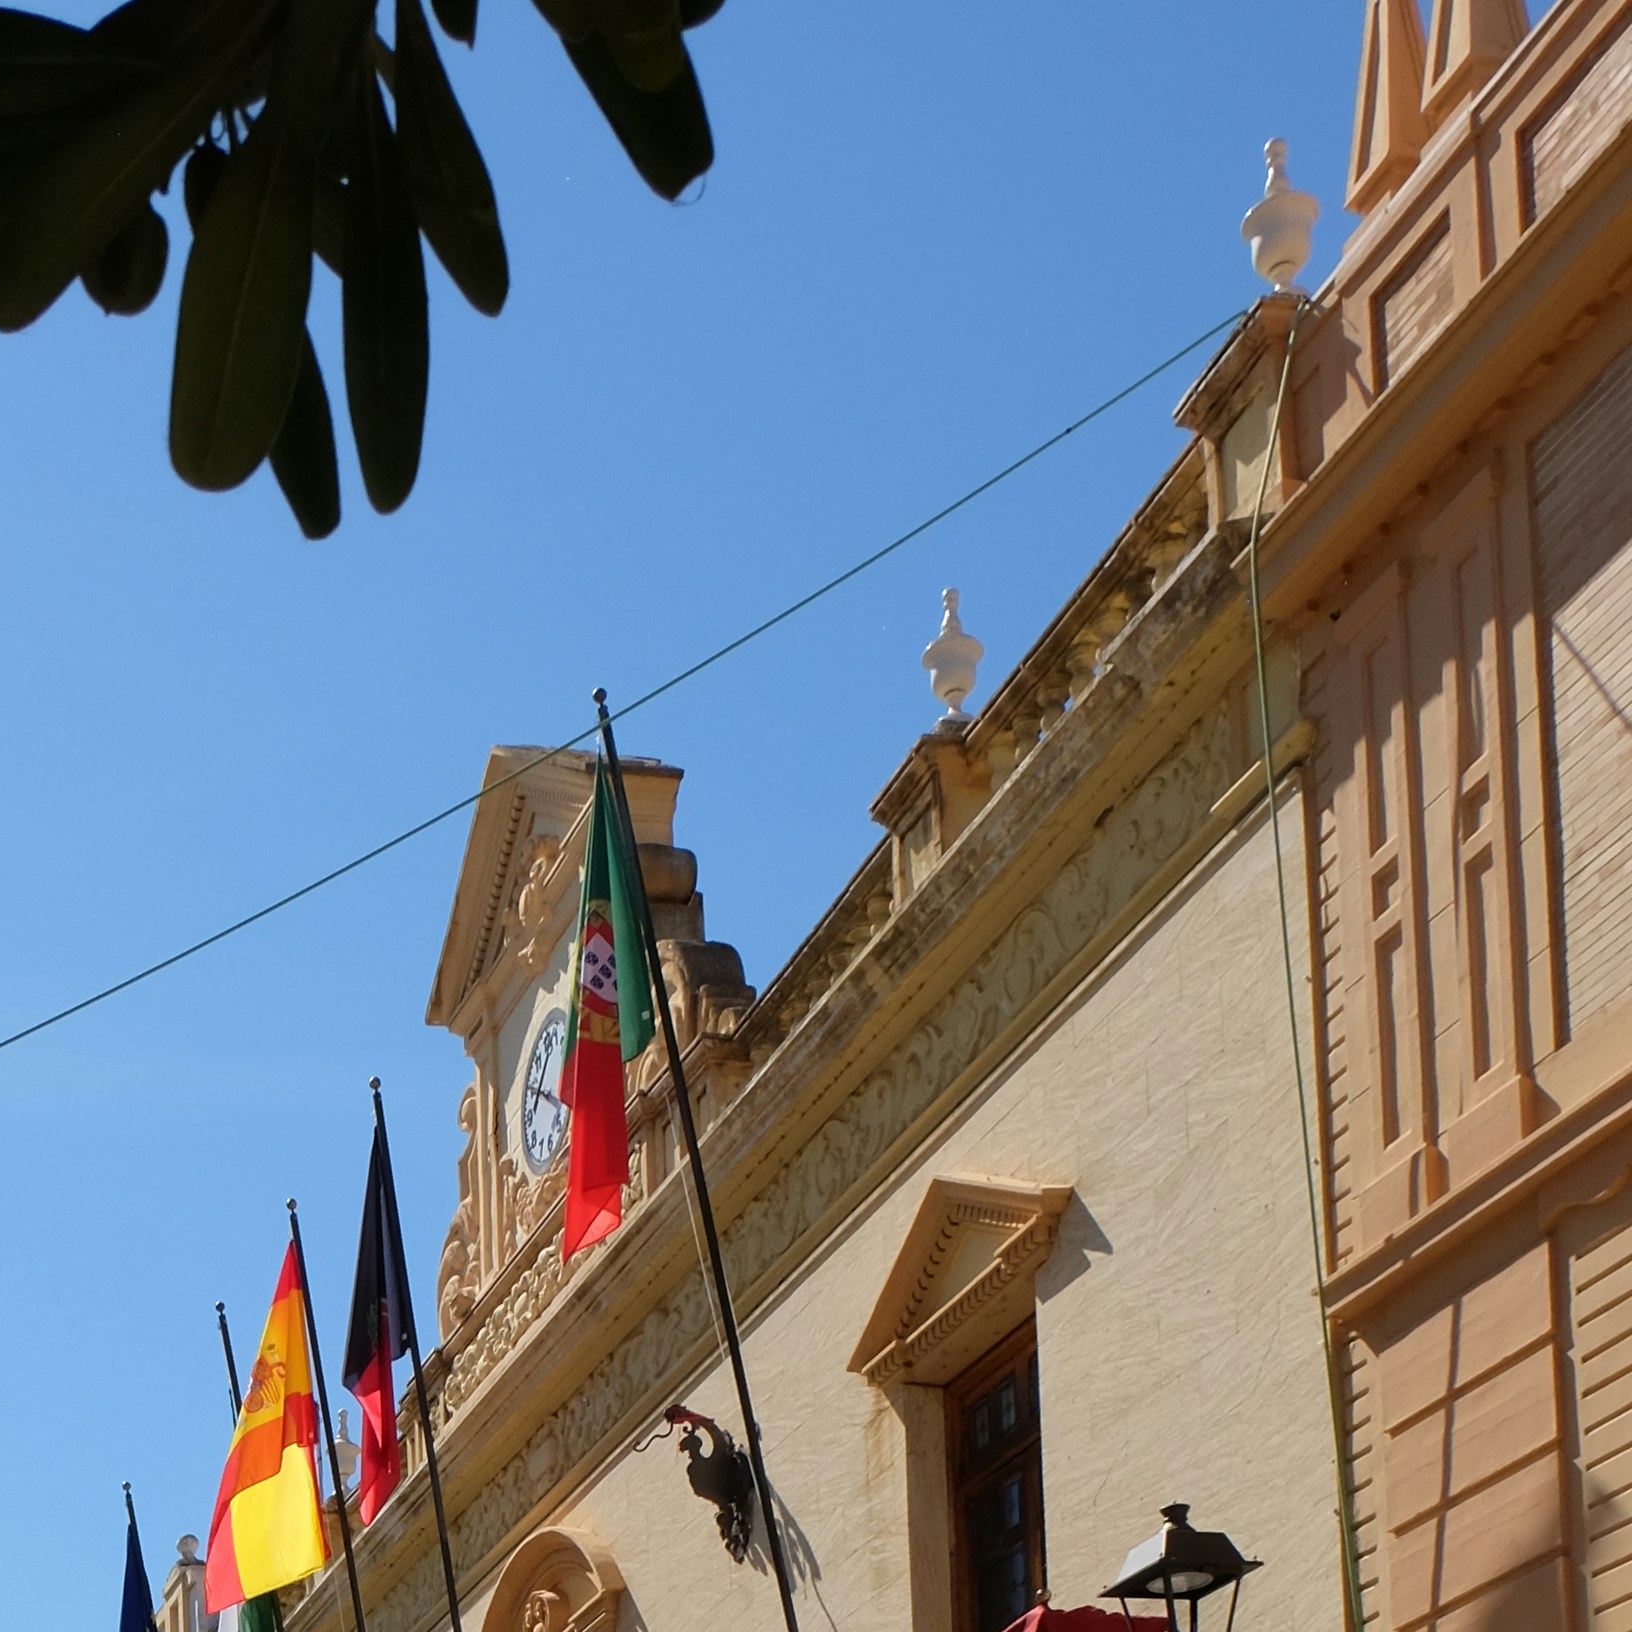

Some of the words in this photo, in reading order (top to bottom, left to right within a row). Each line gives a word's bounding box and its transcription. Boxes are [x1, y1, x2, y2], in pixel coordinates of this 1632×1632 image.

[526, 1108, 534, 1128] 9
[531, 1129, 538, 1149] 8
[547, 1133, 554, 1155] 6
